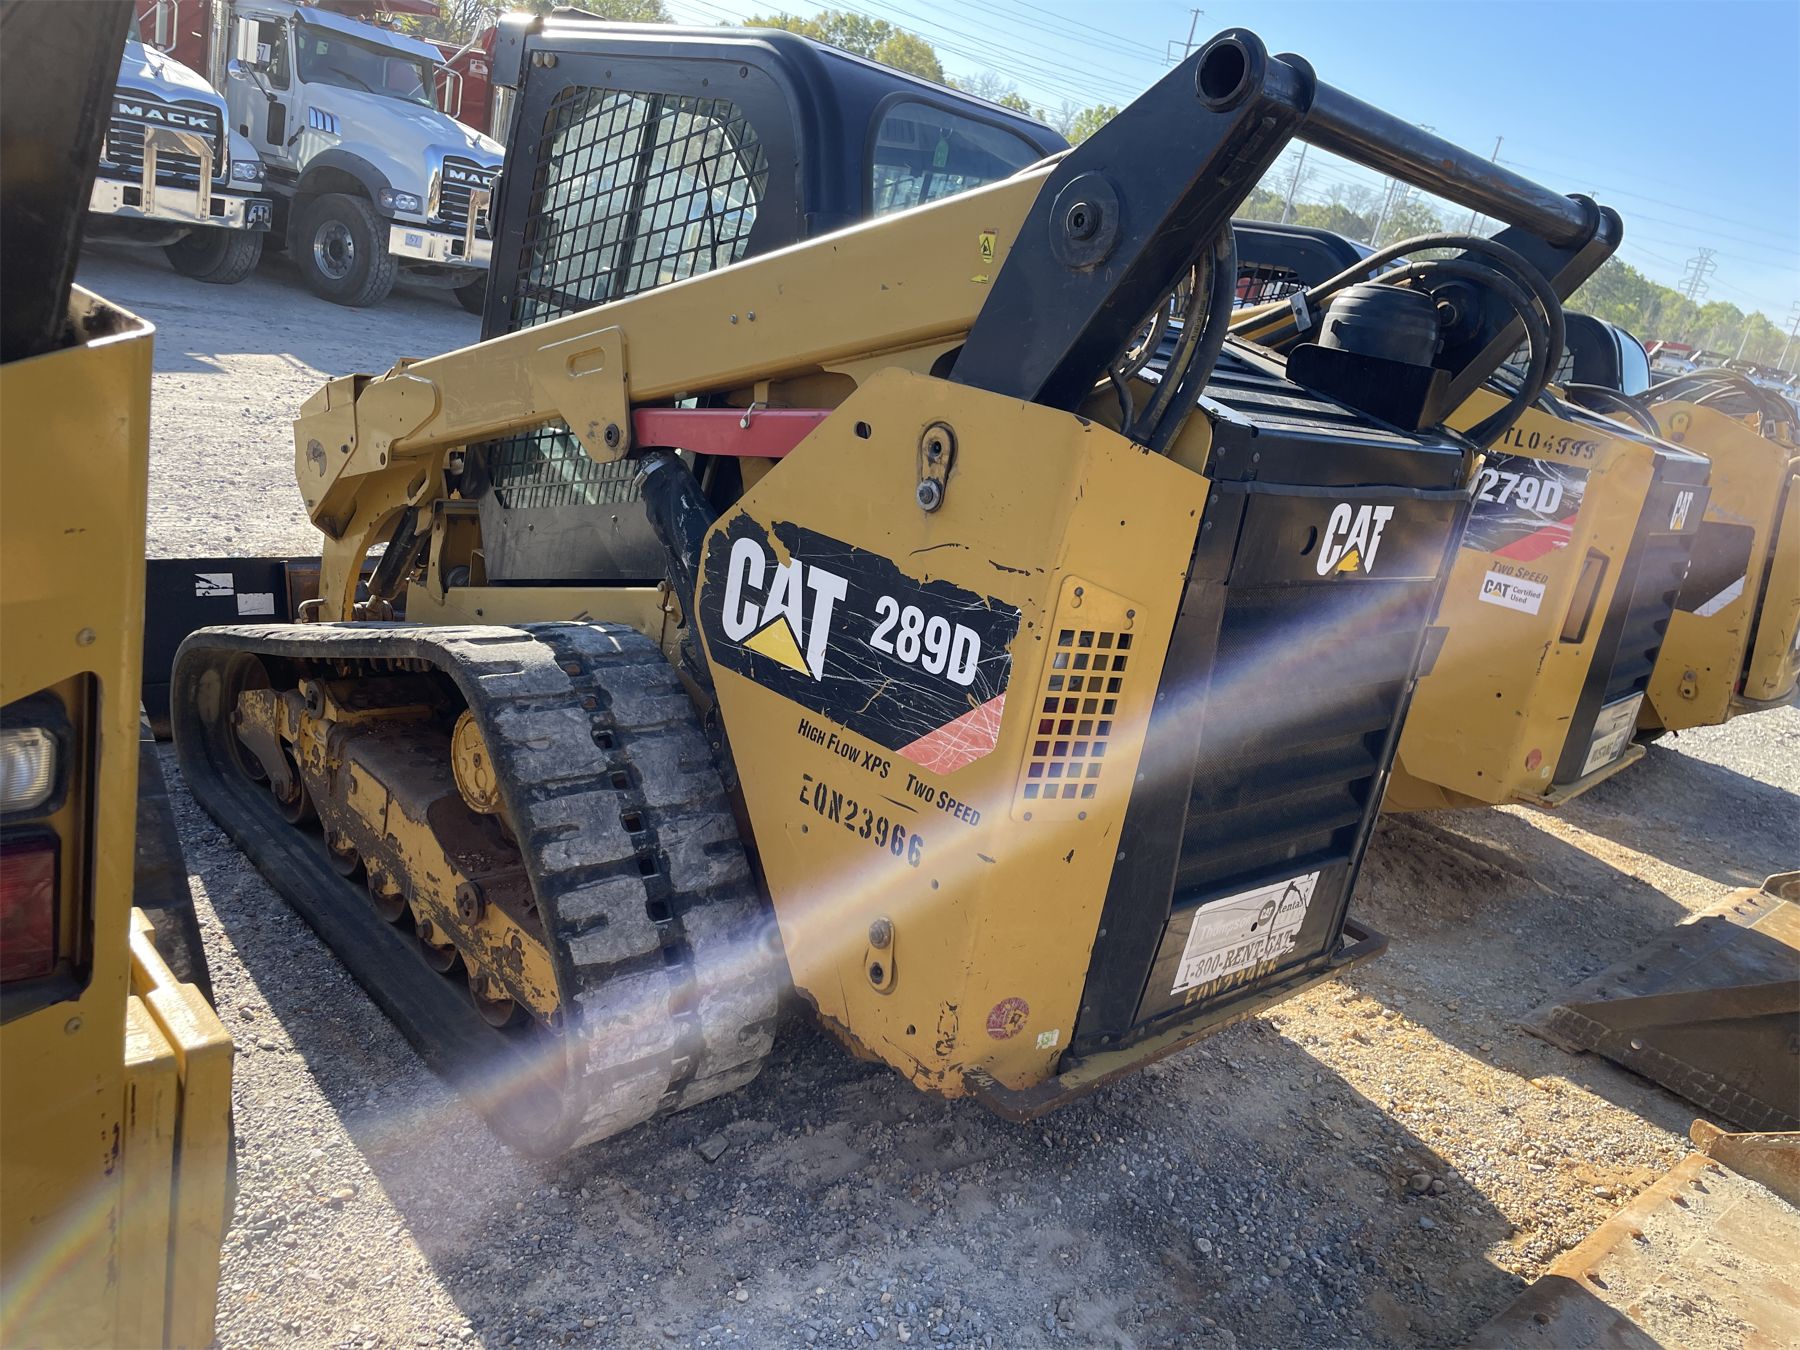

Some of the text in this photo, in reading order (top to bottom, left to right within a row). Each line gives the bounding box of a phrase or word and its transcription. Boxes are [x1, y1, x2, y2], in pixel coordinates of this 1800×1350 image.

[118, 103, 209, 129] MACK
[1478, 468, 1564, 514] 279D
[1669, 490, 1694, 529] CAT
[1316, 502, 1395, 576] CAT
[1483, 579, 1511, 598] CAT
[1510, 593, 1528, 604] Used
[1512, 586, 1541, 599] Certified
[722, 537, 981, 686] CAT 289D
[861, 750, 891, 779] XPS
